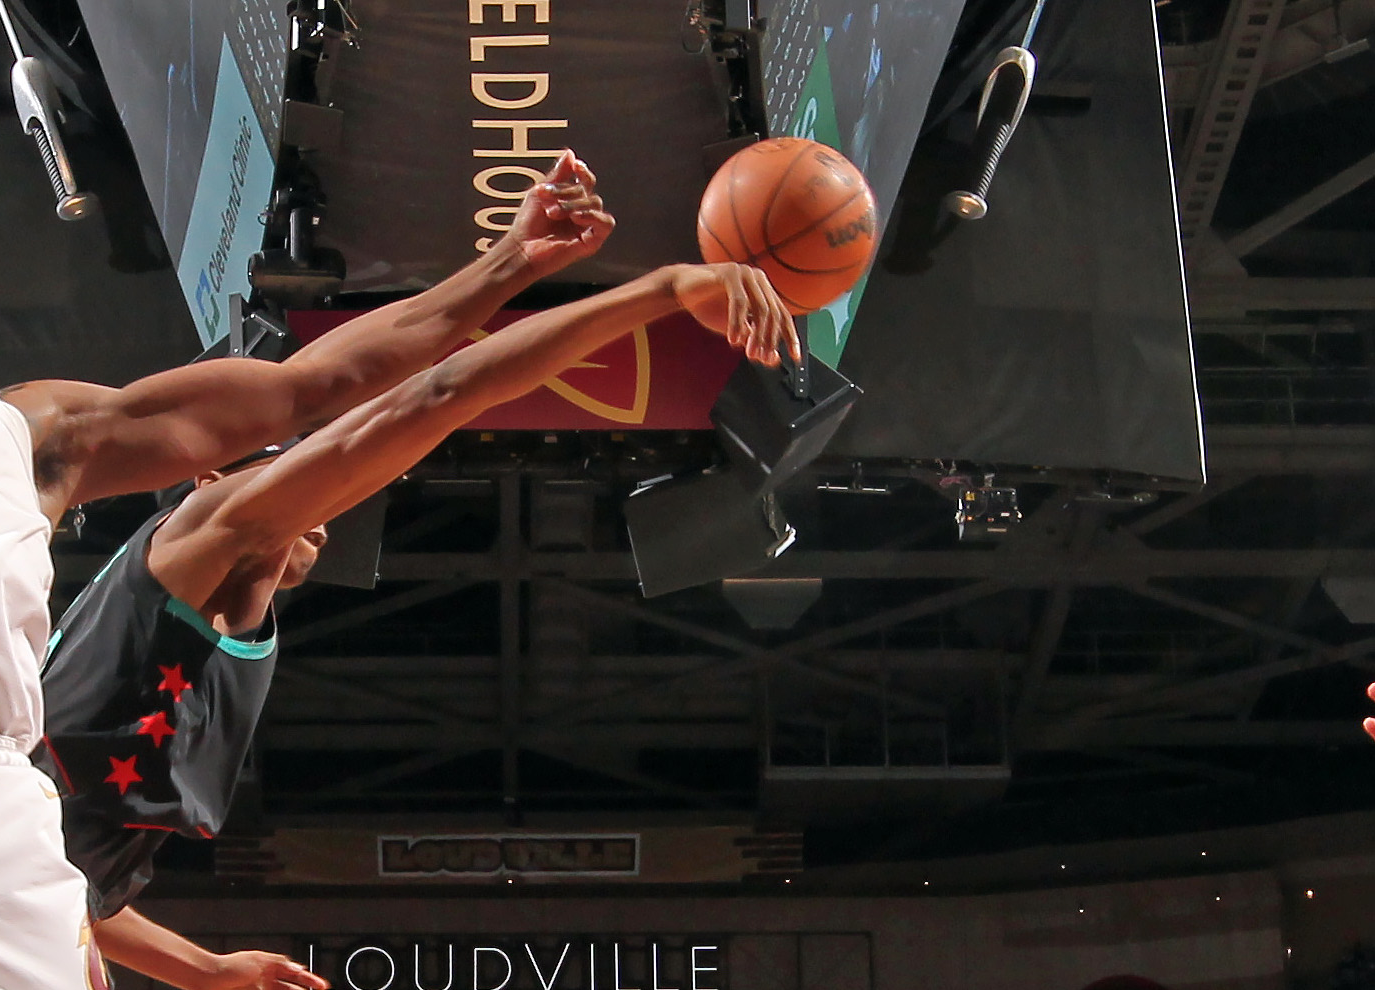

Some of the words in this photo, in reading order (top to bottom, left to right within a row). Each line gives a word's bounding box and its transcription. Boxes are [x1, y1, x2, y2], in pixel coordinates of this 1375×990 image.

[208, 171, 243, 295] Cleveland
[230, 115, 253, 188] Clinic
[469, 0, 568, 254] ELDHOU
